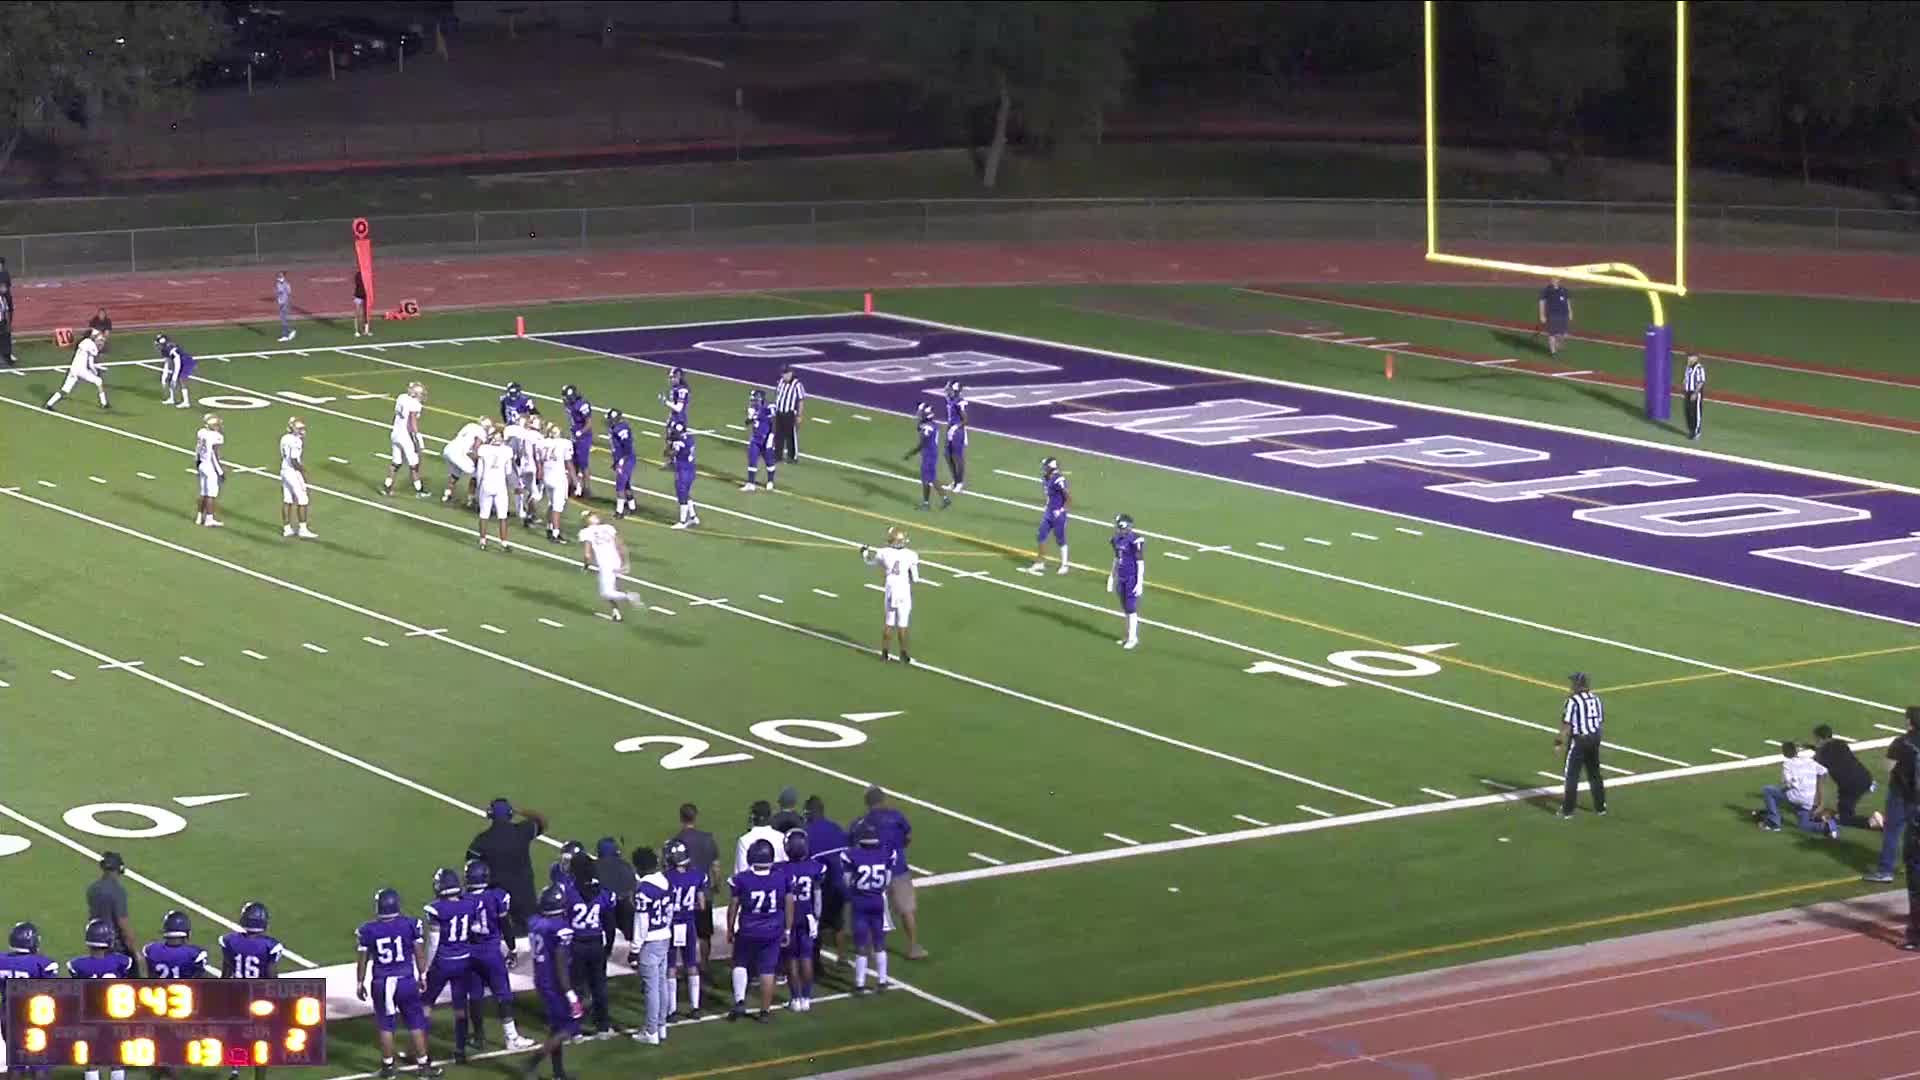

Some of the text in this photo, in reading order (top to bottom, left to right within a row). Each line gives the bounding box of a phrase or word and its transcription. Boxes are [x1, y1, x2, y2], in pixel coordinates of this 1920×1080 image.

[404, 302, 418, 314] G
[1242, 650, 1442, 687] 10
[613, 718, 868, 770] 20
[857, 864, 886, 890] 25
[674, 886, 696, 911] 14
[751, 889, 777, 914] 71
[447, 914, 469, 942] 11
[572, 903, 601, 929] 24
[375, 935, 405, 964] 51
[234, 953, 261, 979] 16
